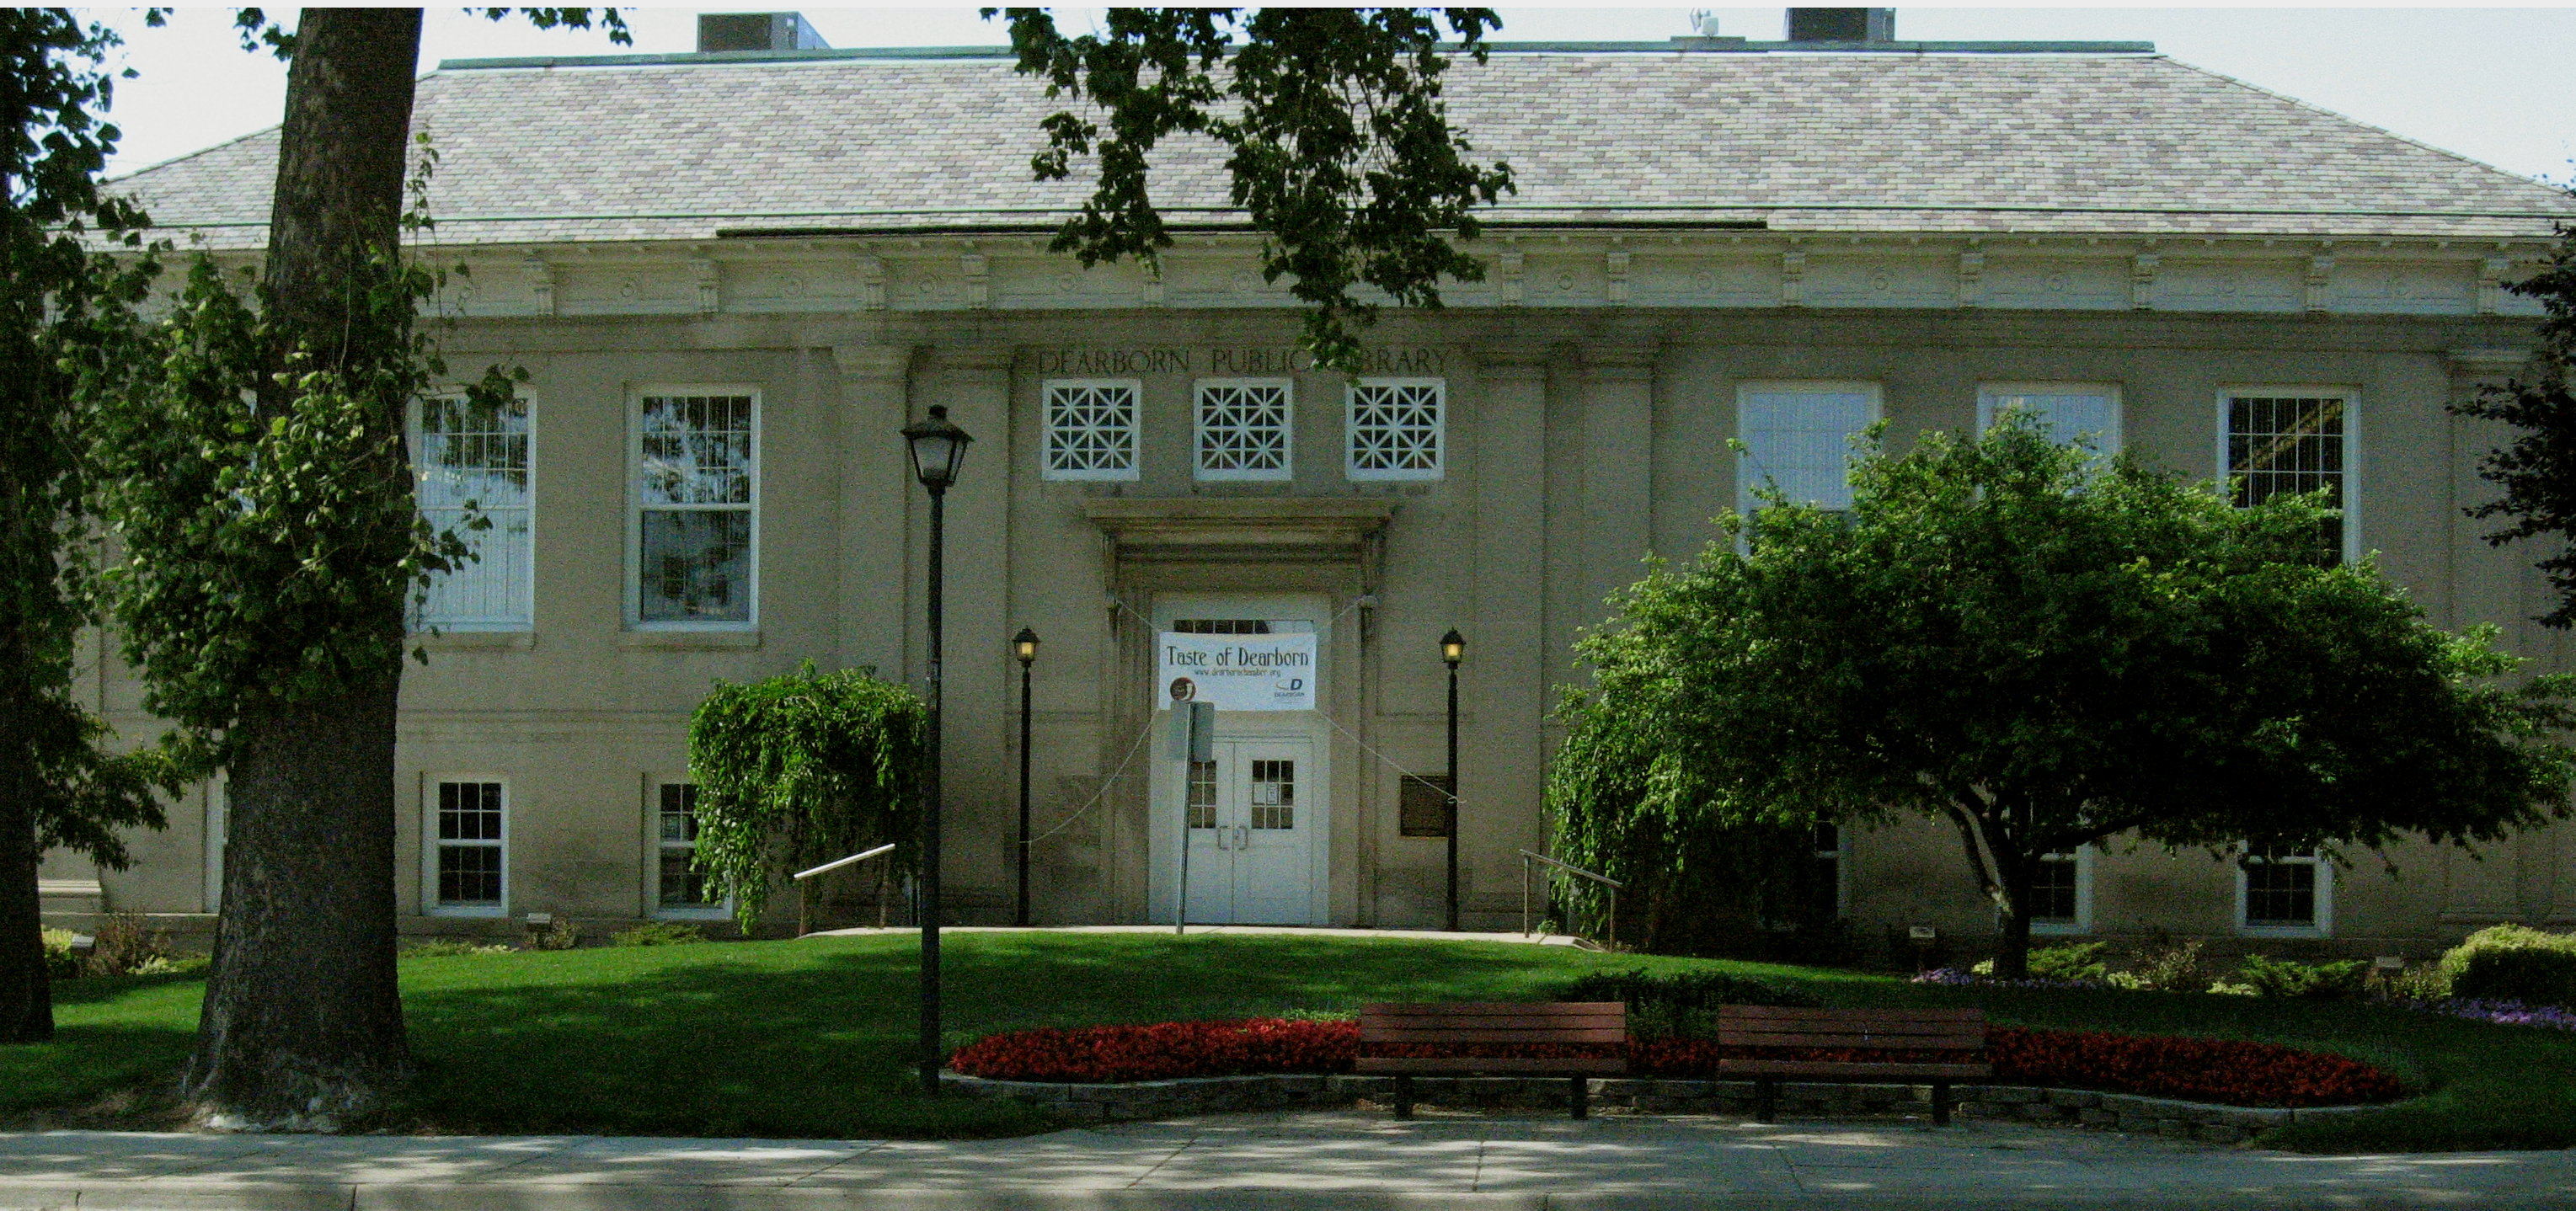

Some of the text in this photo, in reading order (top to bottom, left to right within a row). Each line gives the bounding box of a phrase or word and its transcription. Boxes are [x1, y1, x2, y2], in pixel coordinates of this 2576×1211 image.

[1039, 347, 1451, 373] DEARBORN PUBLIC BRARY
[1167, 646, 1308, 666] Taste of Dearborn
